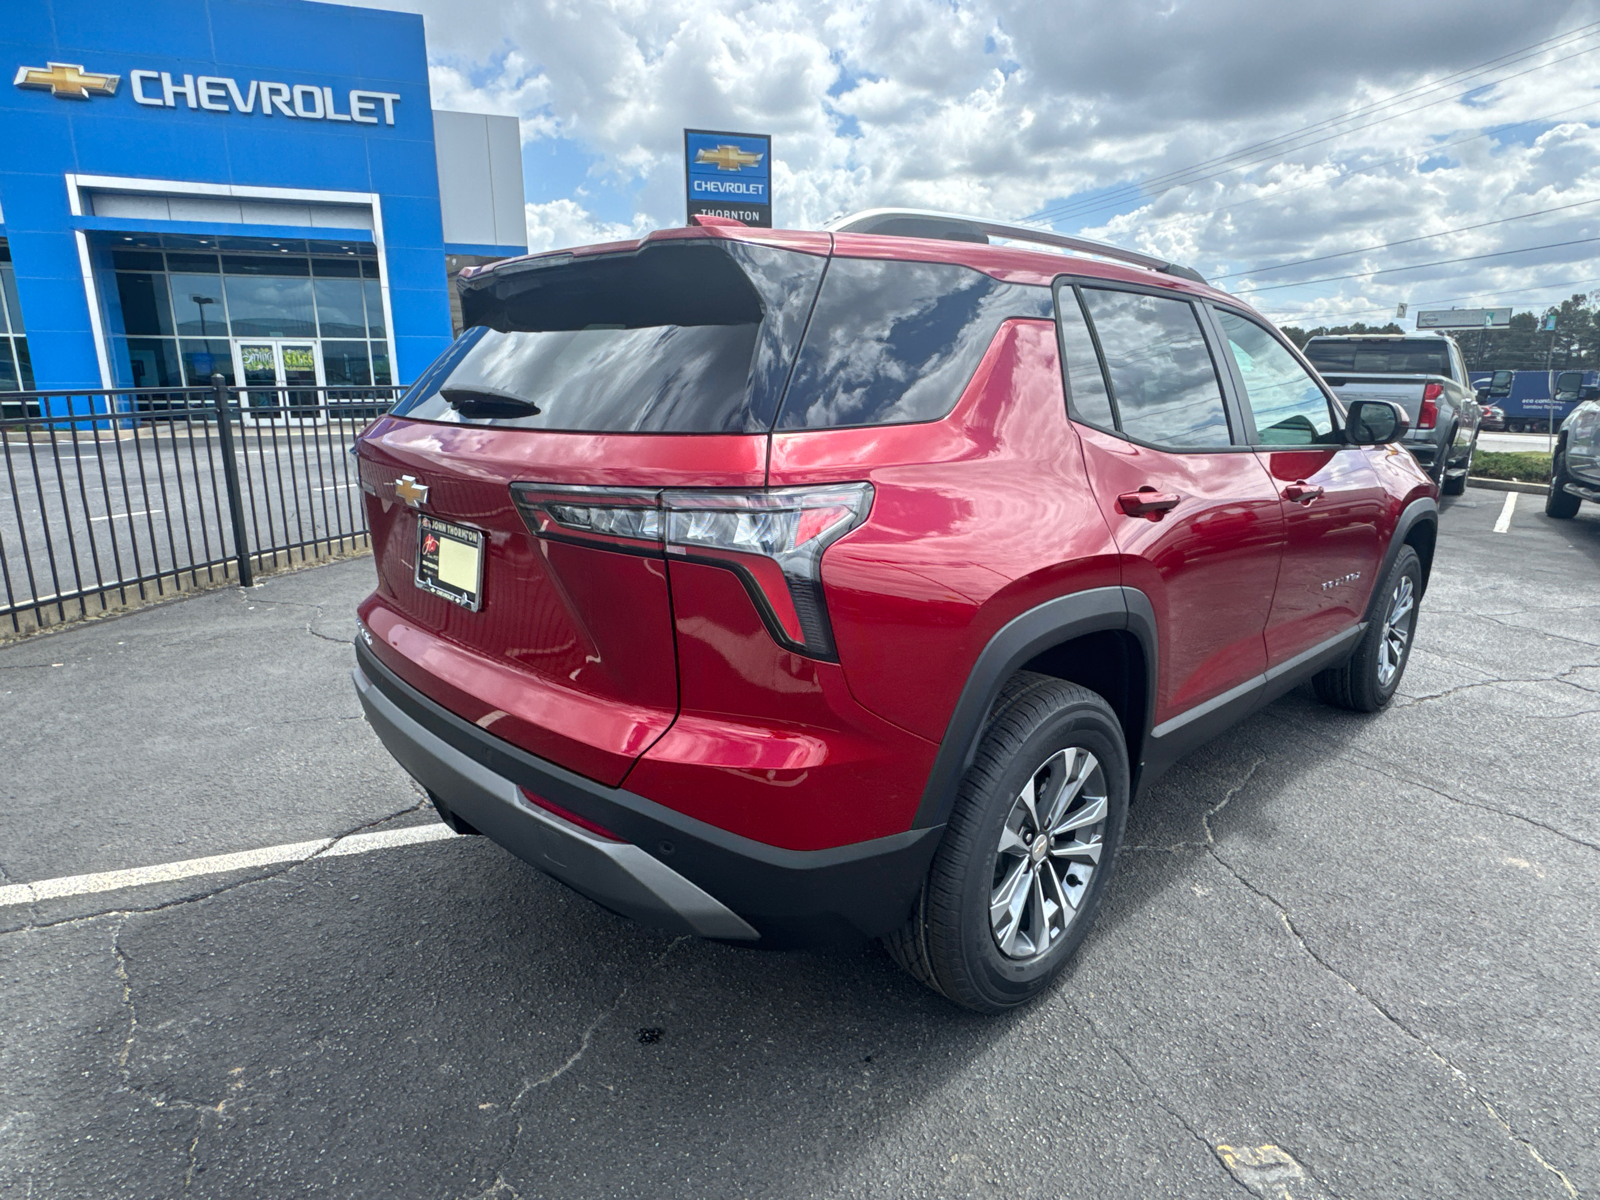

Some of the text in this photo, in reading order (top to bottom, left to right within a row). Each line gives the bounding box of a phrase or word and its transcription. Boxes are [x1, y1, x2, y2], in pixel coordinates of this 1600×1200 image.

[130, 69, 401, 126] CHEVROLET
[694, 180, 764, 195] CHEVROLET
[701, 208, 760, 221] THORNTON
[431, 520, 478, 543] JOHN THORNTON
